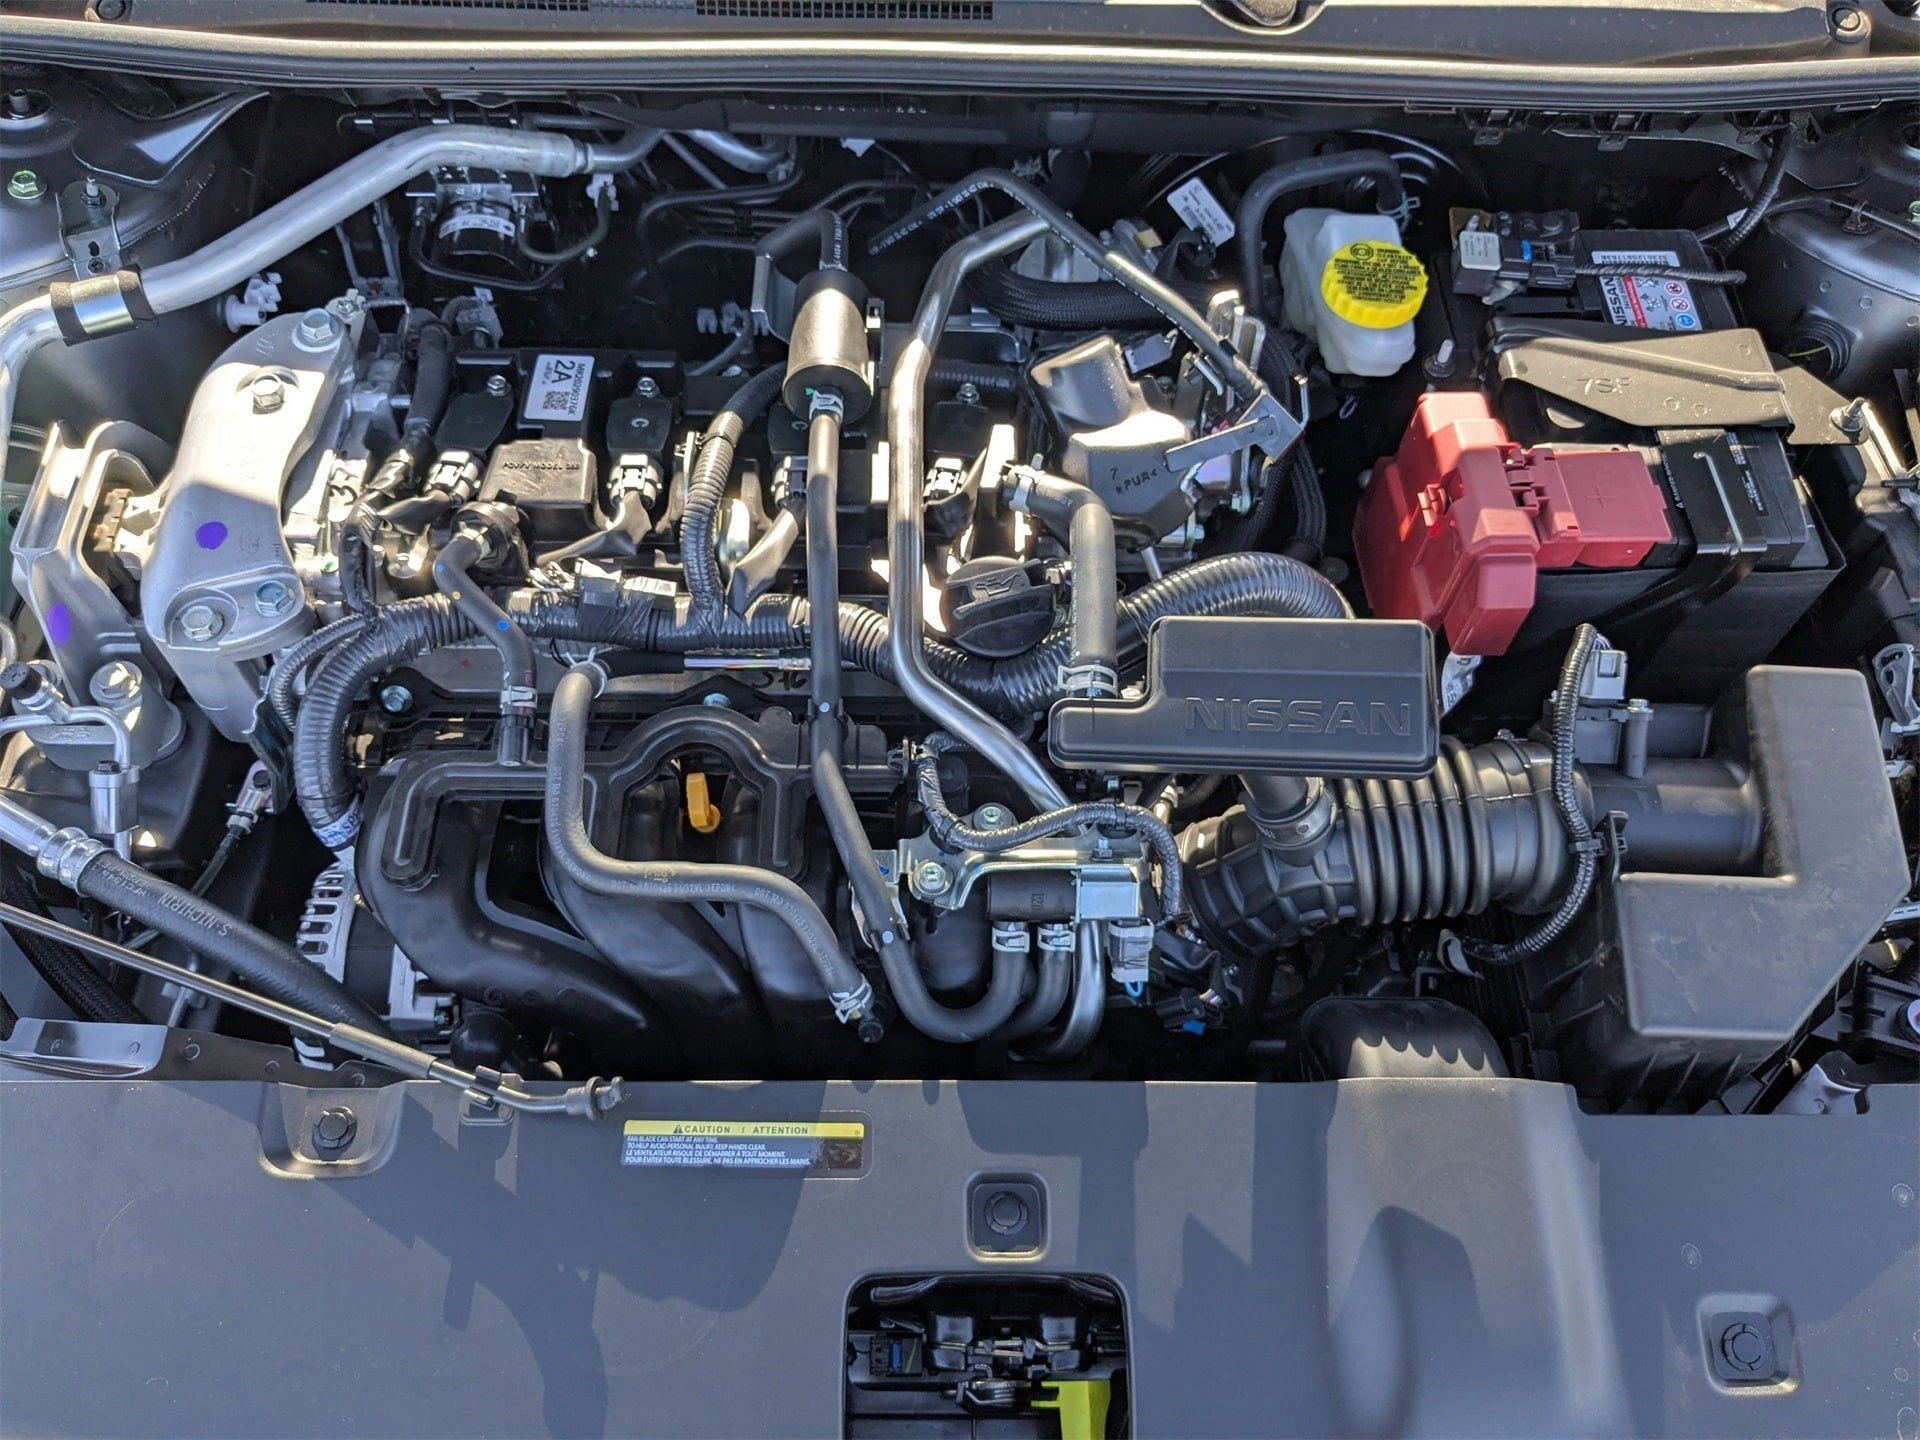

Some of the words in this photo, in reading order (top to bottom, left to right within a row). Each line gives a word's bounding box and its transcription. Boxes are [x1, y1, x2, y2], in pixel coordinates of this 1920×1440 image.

[1604, 276, 1627, 326] NISSAN
[551, 359, 576, 384] 2A
[533, 463, 564, 471] MODEL
[1184, 697, 1411, 737] NISSAN
[684, 1125, 731, 1134] CAUTION
[752, 1126, 809, 1135] ATTENTION
[625, 1156, 642, 1164] POUR
